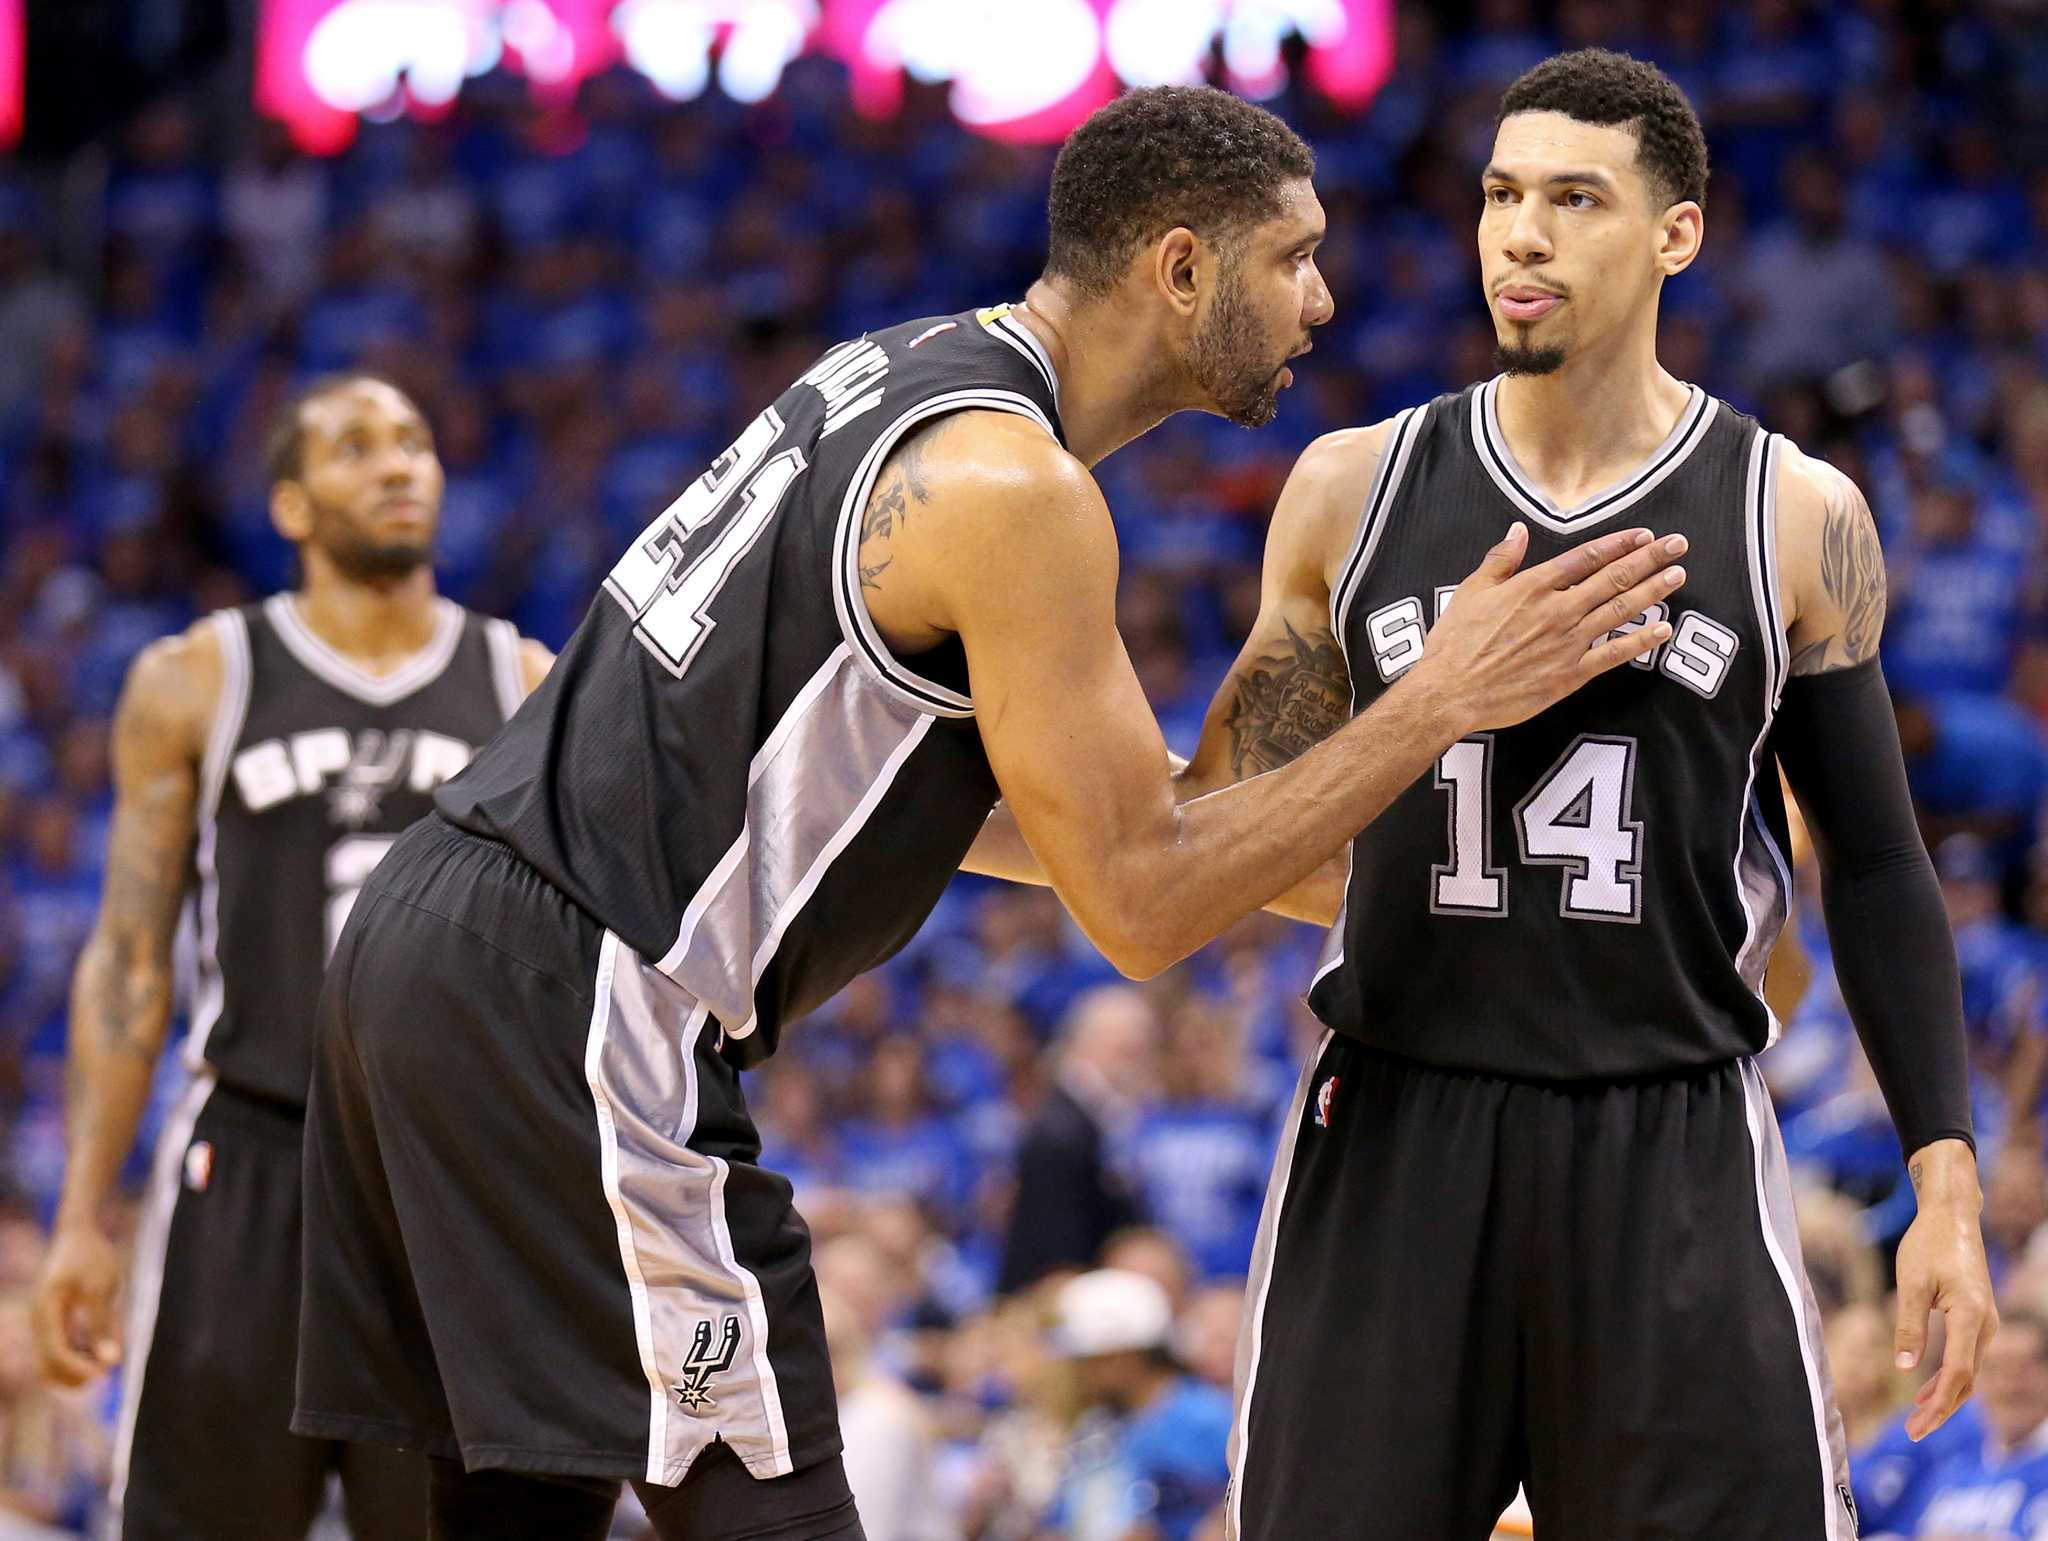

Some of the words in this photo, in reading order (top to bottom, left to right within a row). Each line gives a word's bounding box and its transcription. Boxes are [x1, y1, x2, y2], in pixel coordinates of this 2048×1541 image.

[790, 332, 890, 440] UNCAN
[601, 404, 809, 681] 21
[1365, 584, 1740, 700] SRS
[1430, 733, 1644, 925] 14
